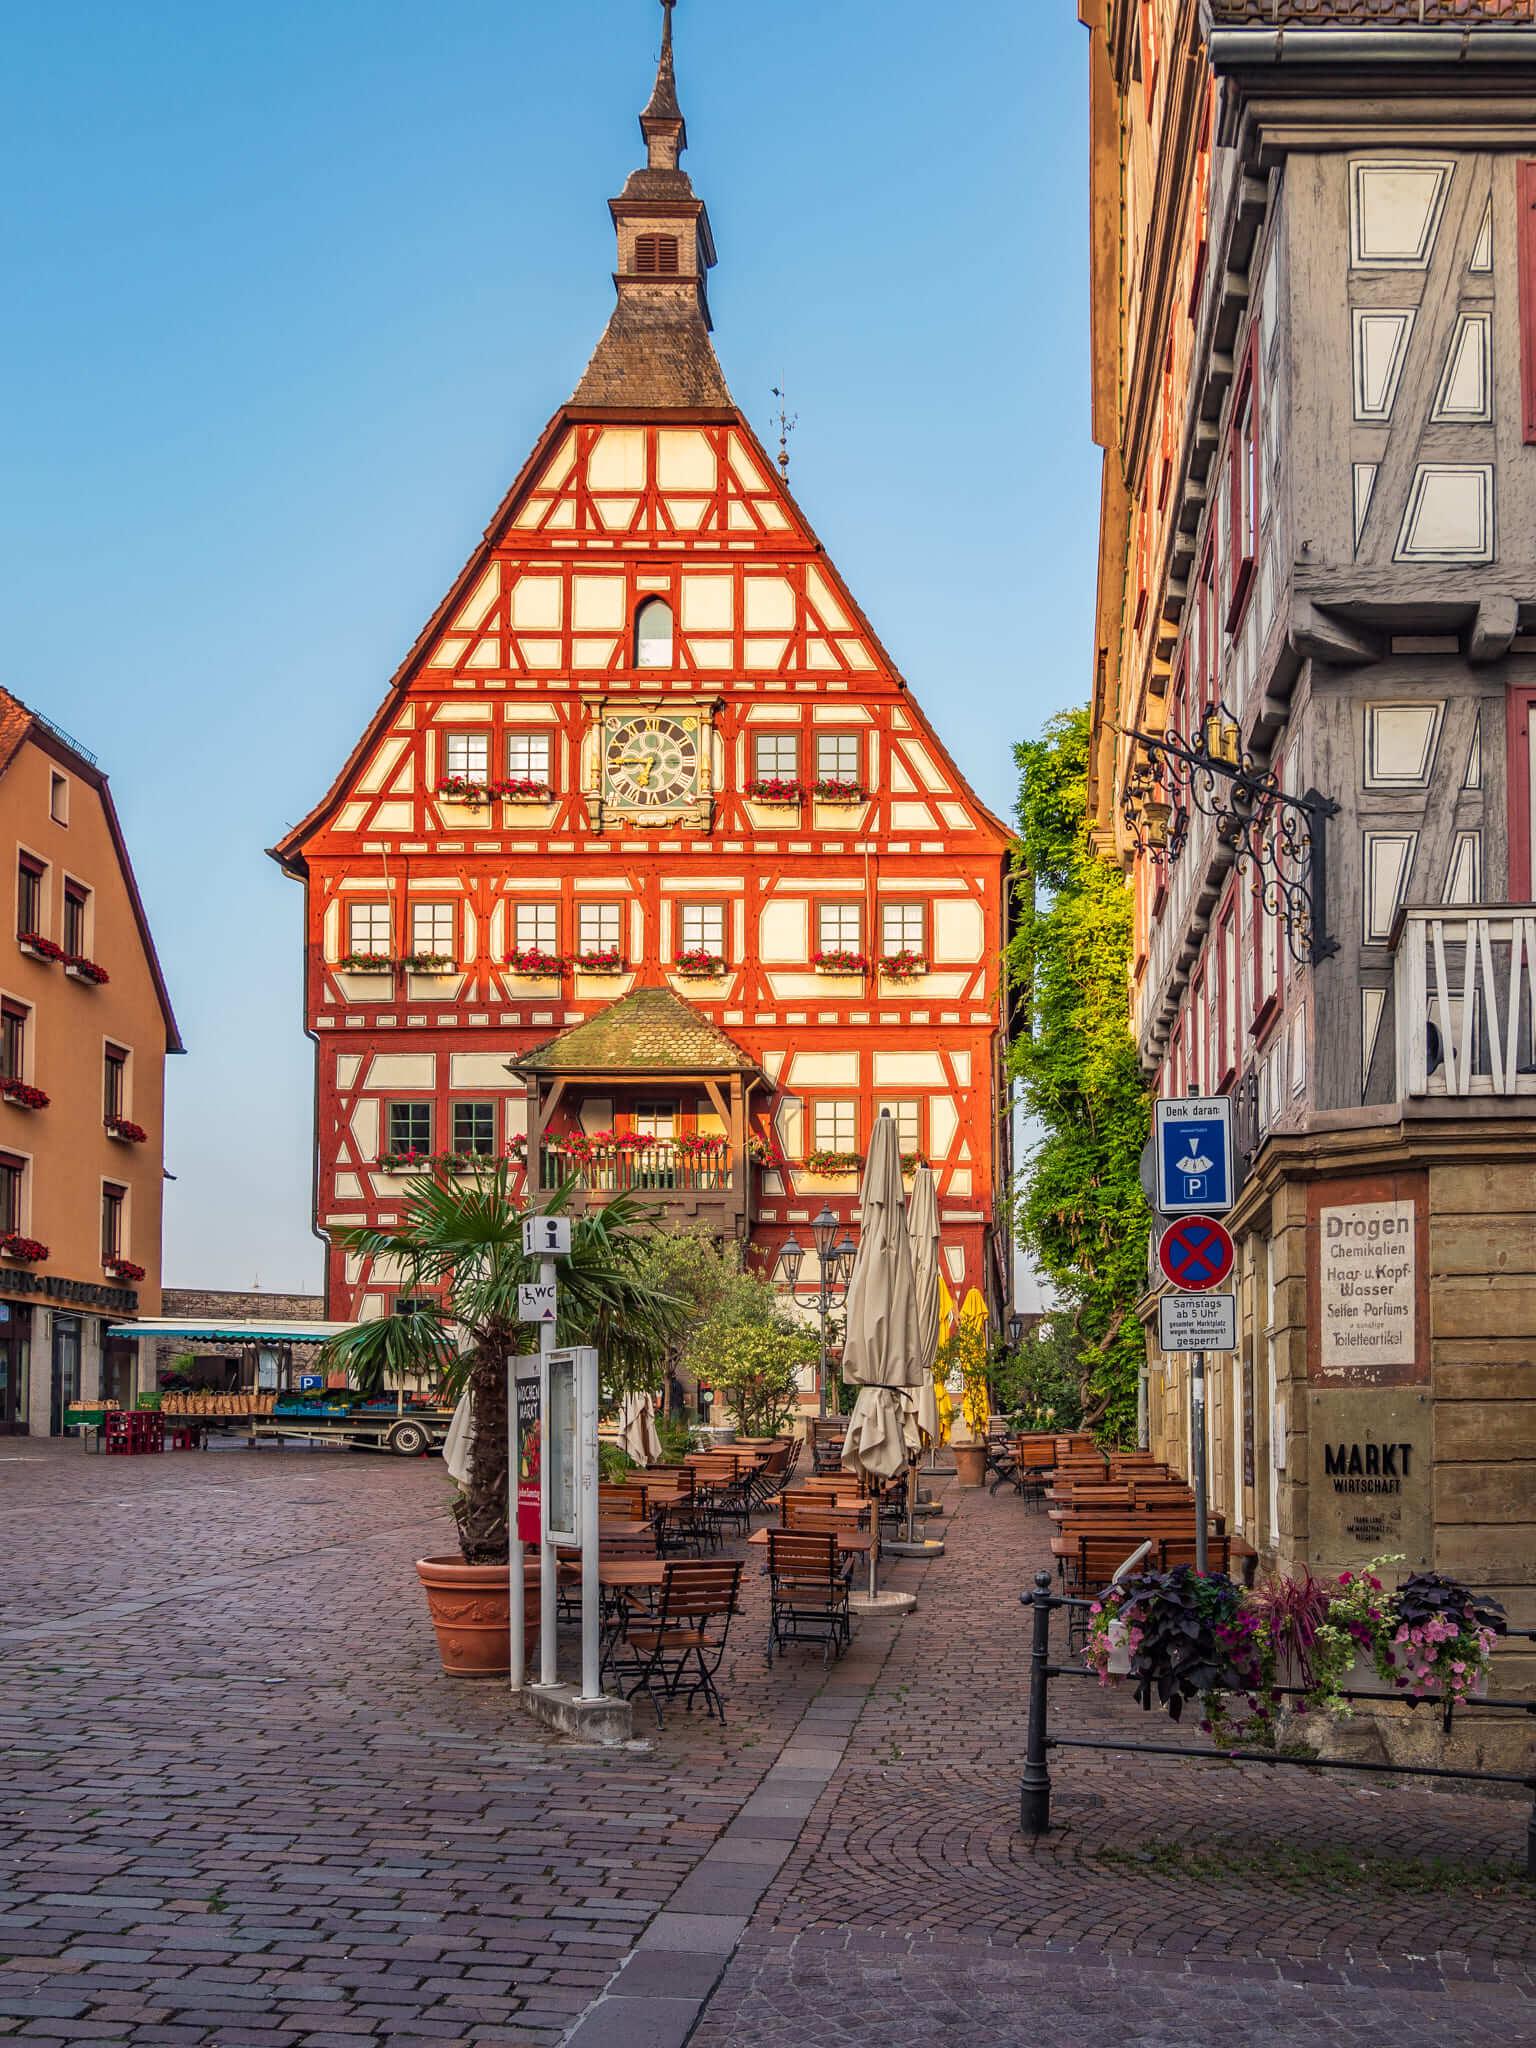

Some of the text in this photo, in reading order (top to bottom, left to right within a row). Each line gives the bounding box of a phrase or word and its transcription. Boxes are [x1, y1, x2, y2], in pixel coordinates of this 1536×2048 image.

[645, 719, 659, 731] XII
[683, 755, 695, 767] III
[1166, 1105, 1221, 1117] Denk daran:
[1189, 1178, 1201, 1195] P
[1326, 1216, 1409, 1241] Drogen
[1330, 1241, 1406, 1259] Chemikalien
[1364, 1269, 1375, 1279] u.
[535, 1287, 555, 1298] WC
[1340, 1282, 1395, 1297] Wasser
[1173, 1300, 1222, 1310] Samstags
[1327, 1303, 1359, 1318] Seifen
[1176, 1309, 1219, 1318] ab 5 Uhr
[1196, 1320, 1226, 1328] Marktplatz
[1176, 1337, 1219, 1347] gesperrt
[1332, 1330, 1403, 1347] Toiletteartikel
[303, 1377, 314, 1389] P
[1324, 1443, 1412, 1476] MARKT
[1333, 1479, 1401, 1494] WIRTSCHAFT
